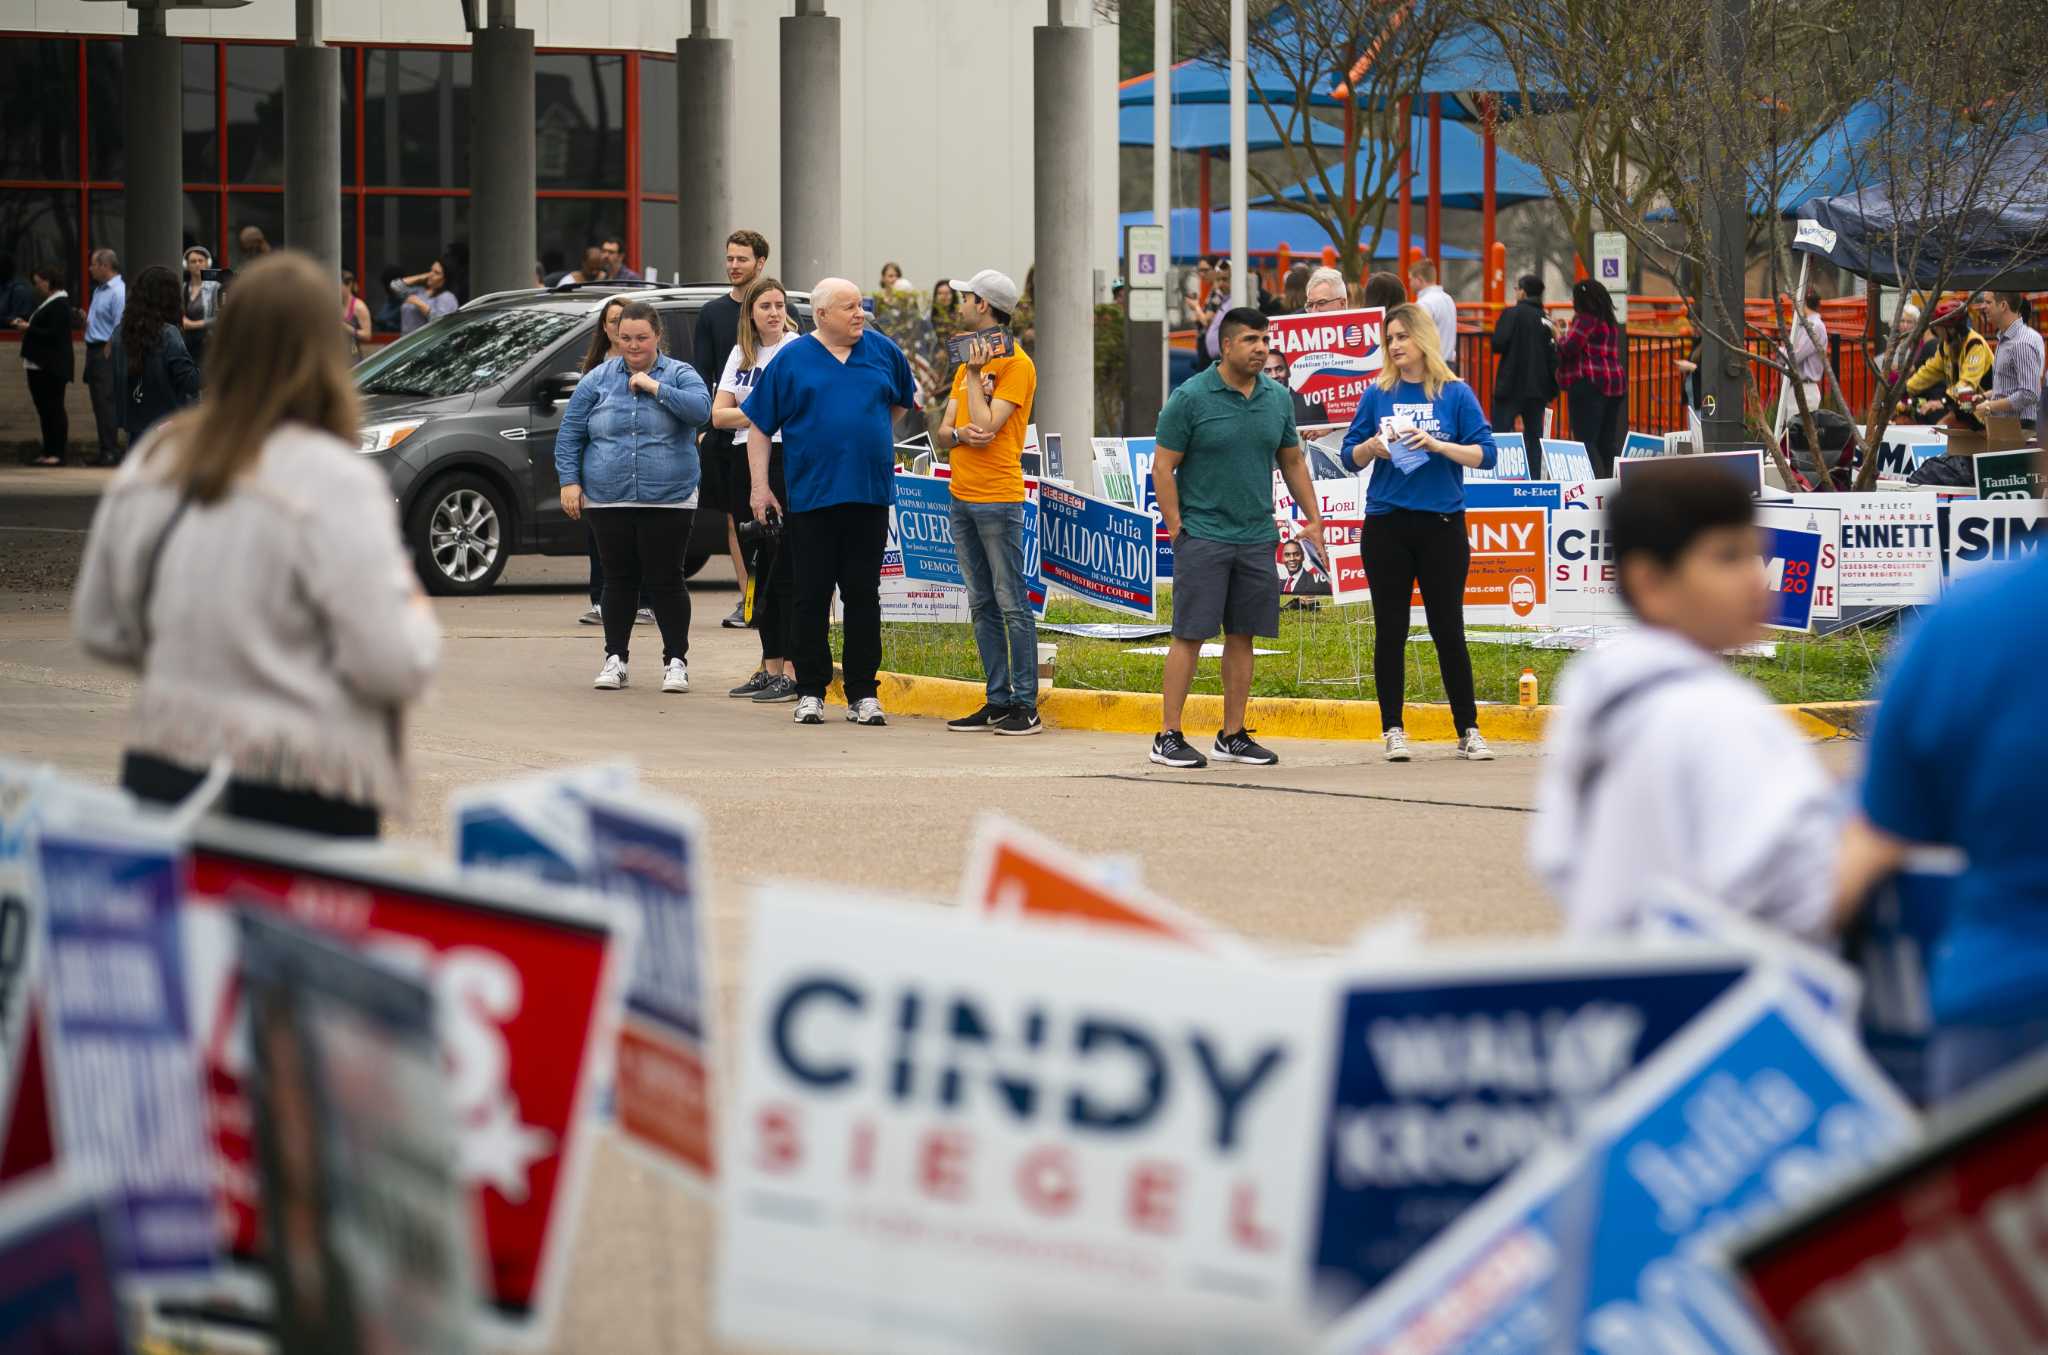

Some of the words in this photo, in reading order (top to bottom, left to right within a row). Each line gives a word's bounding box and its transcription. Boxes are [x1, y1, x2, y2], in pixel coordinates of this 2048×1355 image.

[1303, 387, 1336, 407] VOTE
[896, 483, 922, 497] JUDGE
[1983, 474, 2028, 489] Tamika
[1041, 484, 1085, 510] RE-ELECT
[1513, 487, 1558, 498] Re-Elect
[1046, 500, 1078, 518] JUDGE
[1321, 496, 1355, 513] LORI
[1105, 513, 1142, 541] Julia
[1041, 511, 1151, 585] MALDONADO
[1785, 560, 1811, 577] 20
[1071, 572, 1104, 593] DISTRICT
[1106, 584, 1136, 601] COURT
[1091, 571, 1129, 588] DEMOCRAT
[1783, 577, 1809, 595] 20
[766, 971, 1292, 1156] CINDY
[751, 1102, 1288, 1257] SIEGEL
